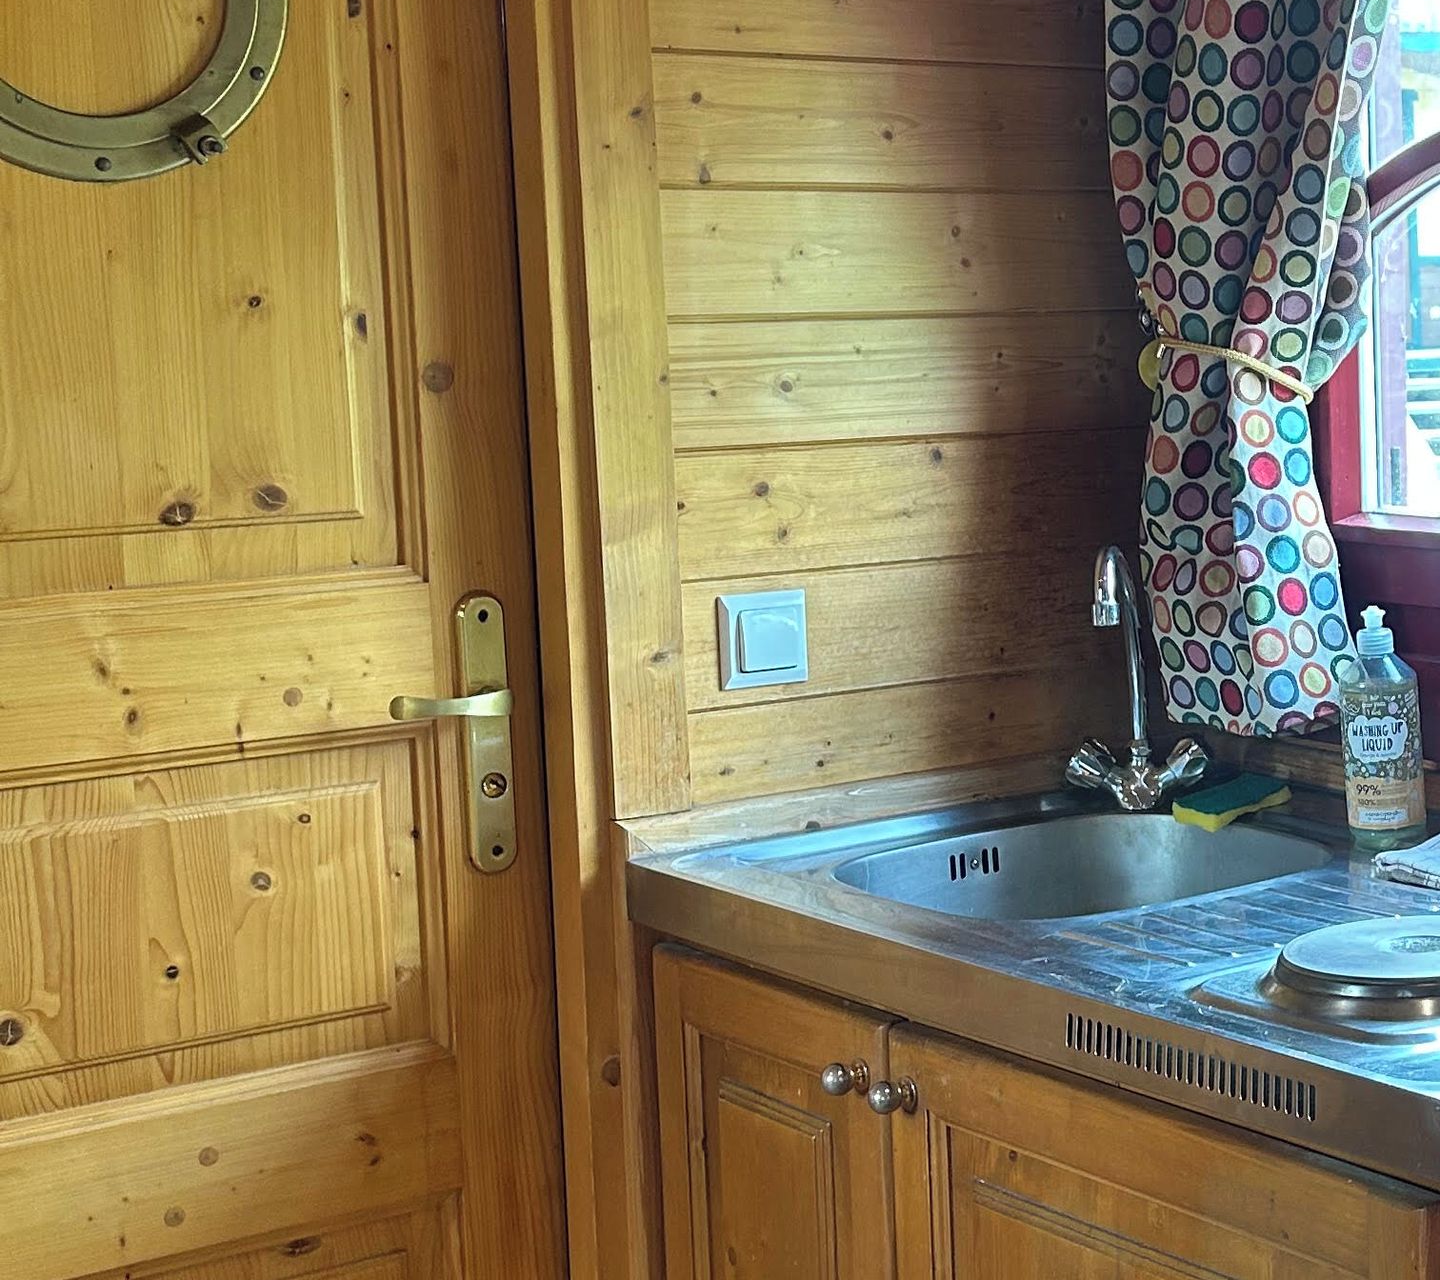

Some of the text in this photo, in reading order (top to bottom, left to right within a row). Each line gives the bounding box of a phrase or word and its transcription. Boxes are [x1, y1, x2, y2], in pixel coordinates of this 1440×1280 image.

[1352, 721, 1403, 737] WASHING UP
[1361, 738, 1393, 752] LIQUID
[1356, 784, 1381, 796] 99%
